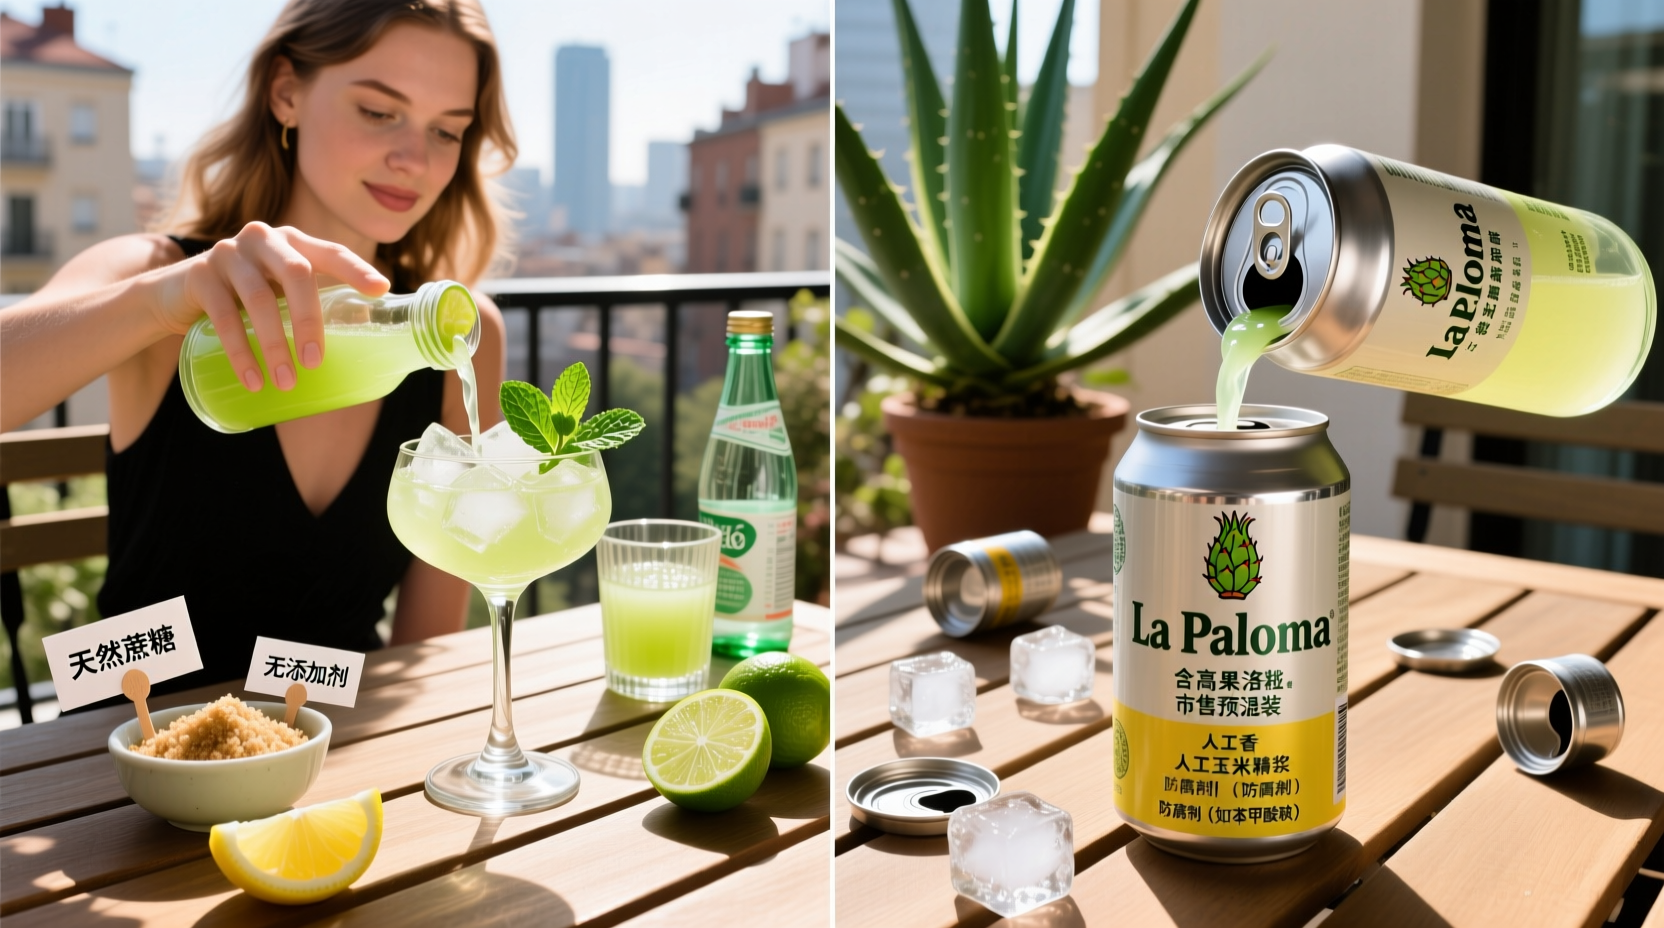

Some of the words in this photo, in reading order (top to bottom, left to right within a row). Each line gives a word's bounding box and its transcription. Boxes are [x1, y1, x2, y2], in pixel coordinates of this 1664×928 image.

[1132, 600, 1171, 651] La
[1181, 610, 1331, 656] Paloma
[68, 624, 176, 681] 天然蔗糖
[263, 655, 350, 689] 无添加剂
[1201, 733, 1259, 752] 人工香
